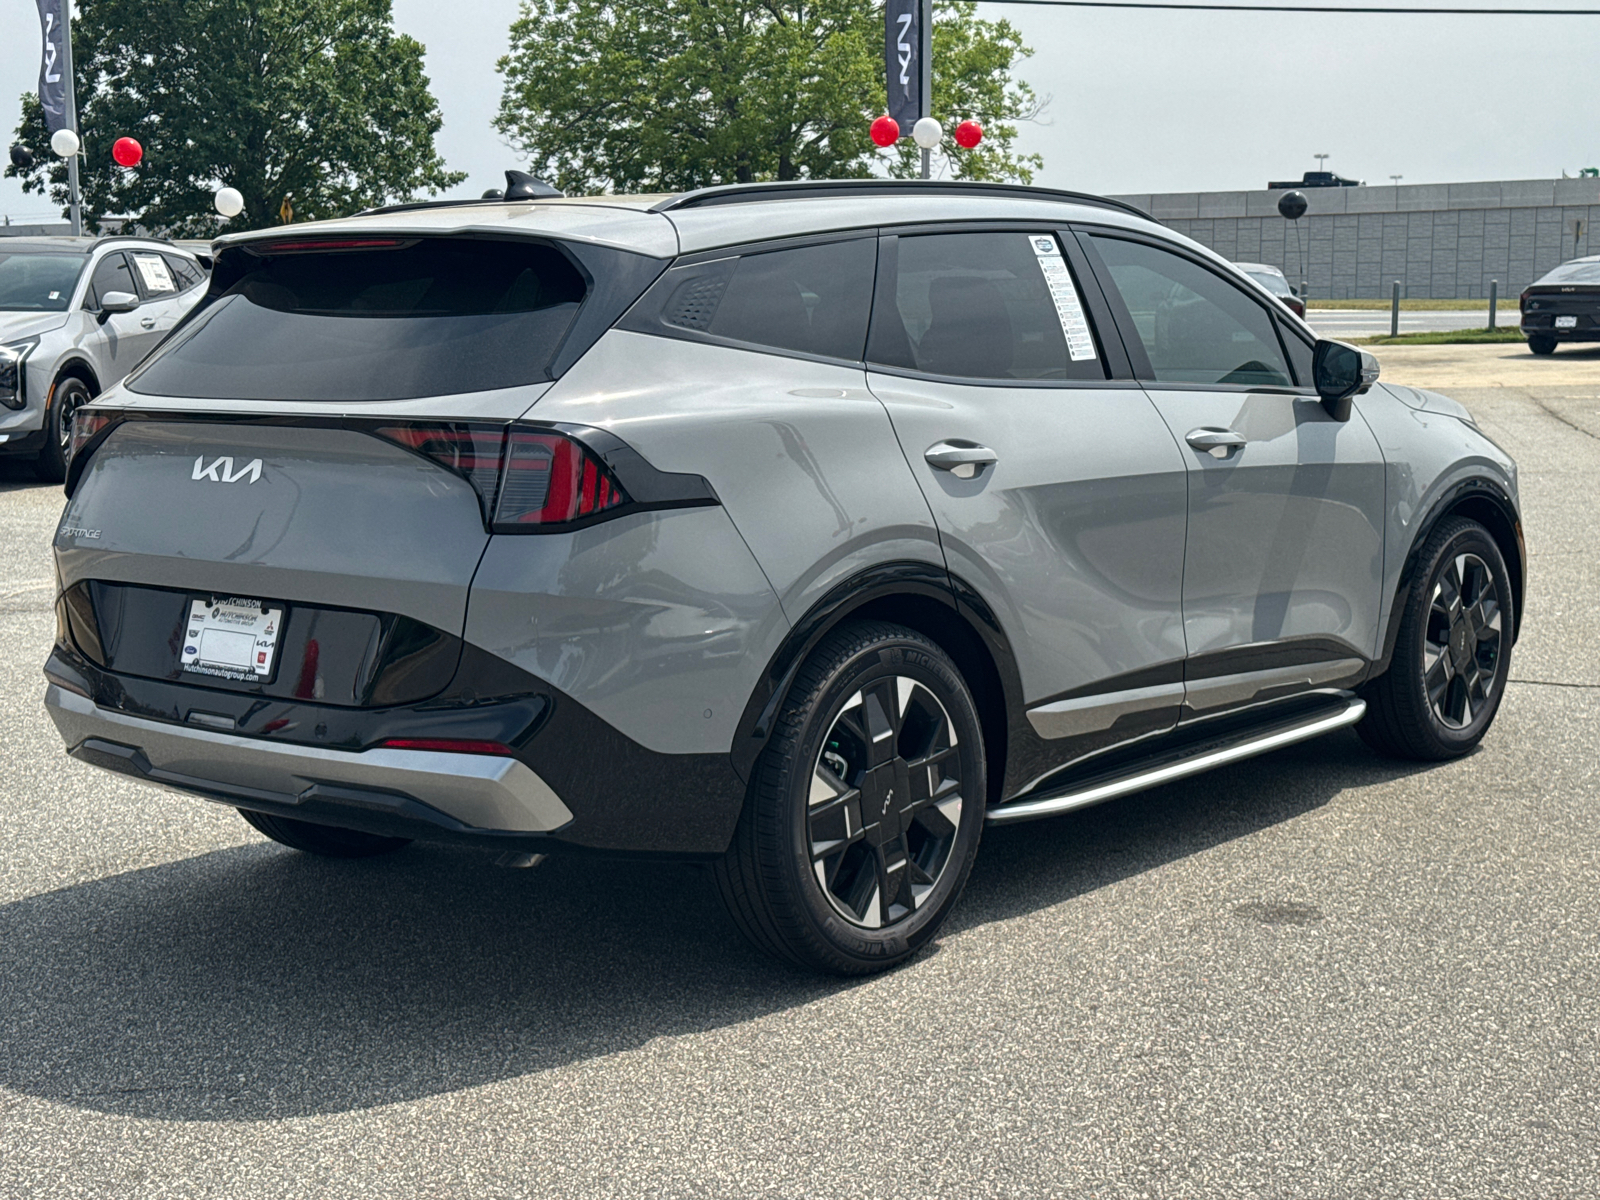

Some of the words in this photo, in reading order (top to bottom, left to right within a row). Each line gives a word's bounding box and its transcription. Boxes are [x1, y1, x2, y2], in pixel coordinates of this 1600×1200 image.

[191, 454, 263, 485] KIA
[60, 526, 101, 539] SPORTAGE
[183, 664, 259, 681] Hutchinsonautogroup.com
